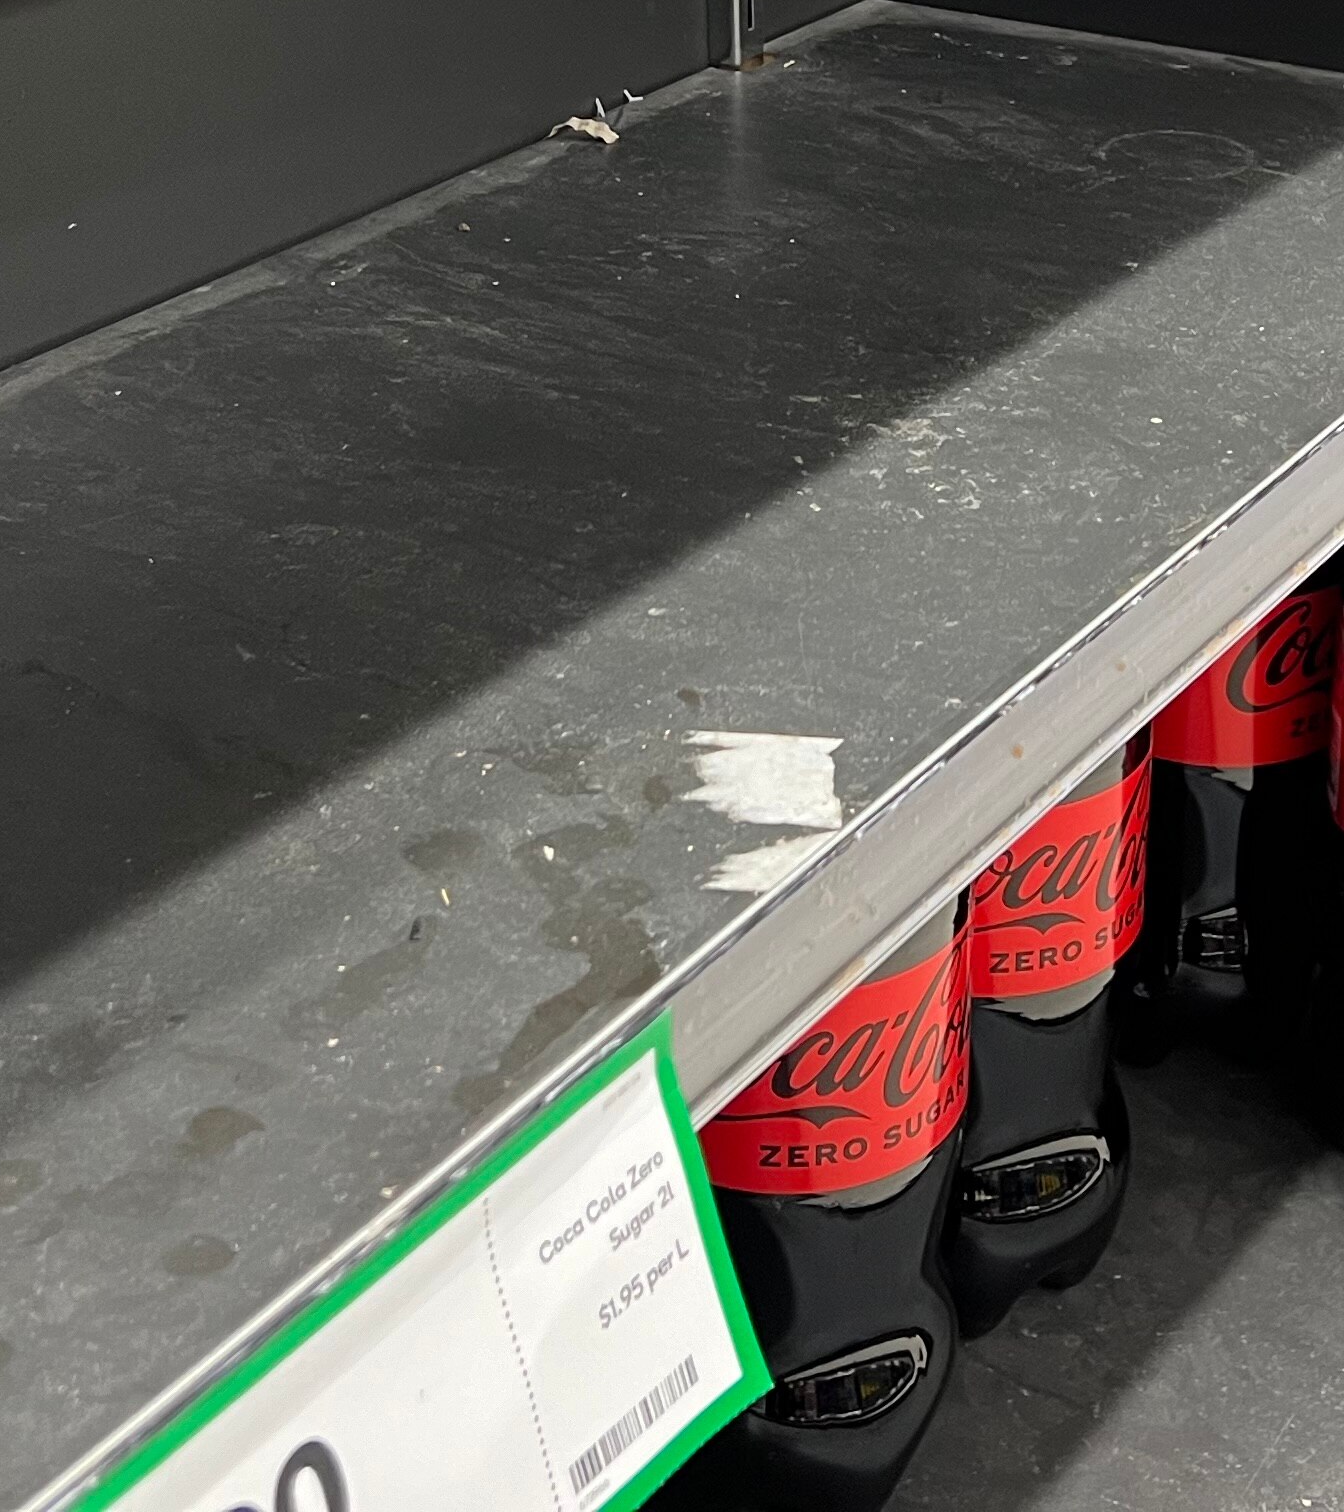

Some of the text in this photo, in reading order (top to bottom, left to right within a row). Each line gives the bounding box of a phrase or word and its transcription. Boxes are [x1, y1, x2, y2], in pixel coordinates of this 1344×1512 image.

[989, 941, 1082, 974] ZERO
[759, 1138, 868, 1168] ZERO
[539, 1151, 664, 1264] Coca Cola Zero
[609, 1200, 656, 1251] Sugar
[598, 1238, 690, 1328] $1.95 per L
